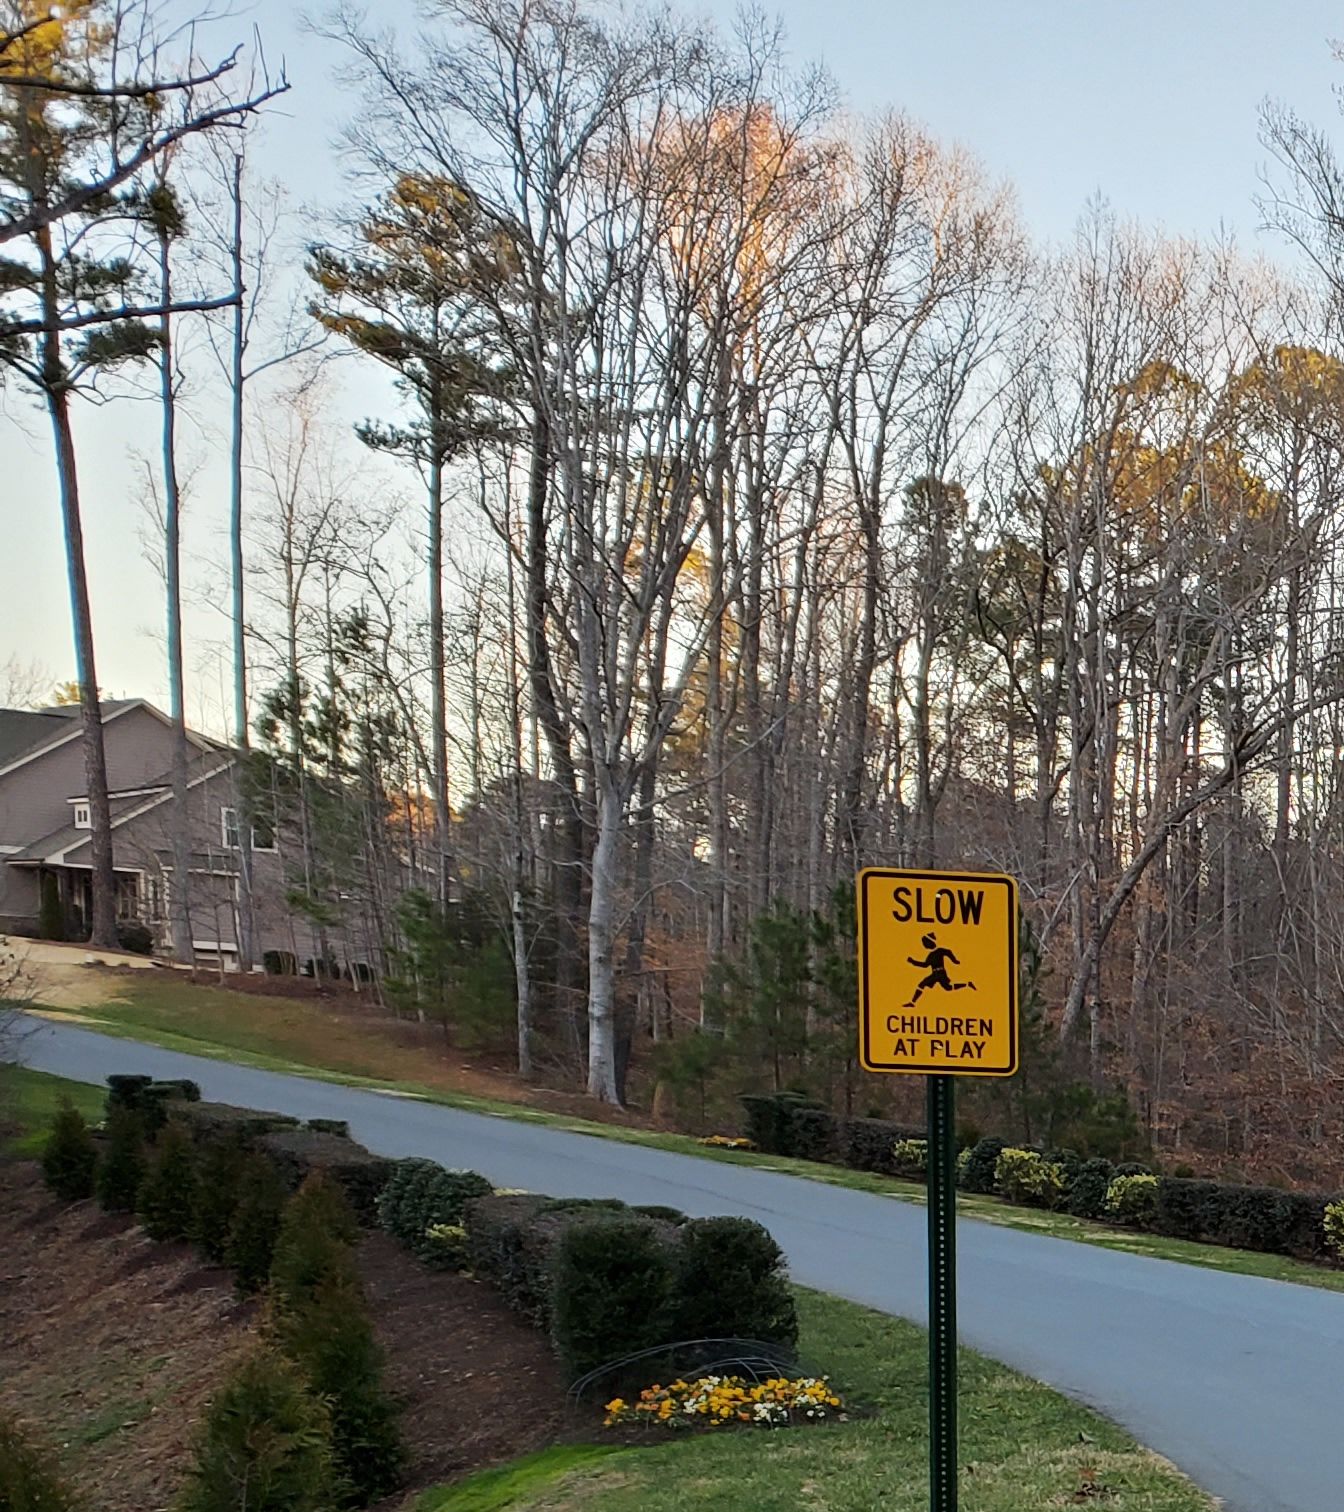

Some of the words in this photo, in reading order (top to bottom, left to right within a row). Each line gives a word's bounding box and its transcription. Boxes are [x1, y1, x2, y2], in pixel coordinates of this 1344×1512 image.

[892, 887, 985, 925] SLOW
[886, 1015, 993, 1037] CHILDREN
[893, 1038, 920, 1057] AT
[930, 1039, 986, 1059] PLAY
